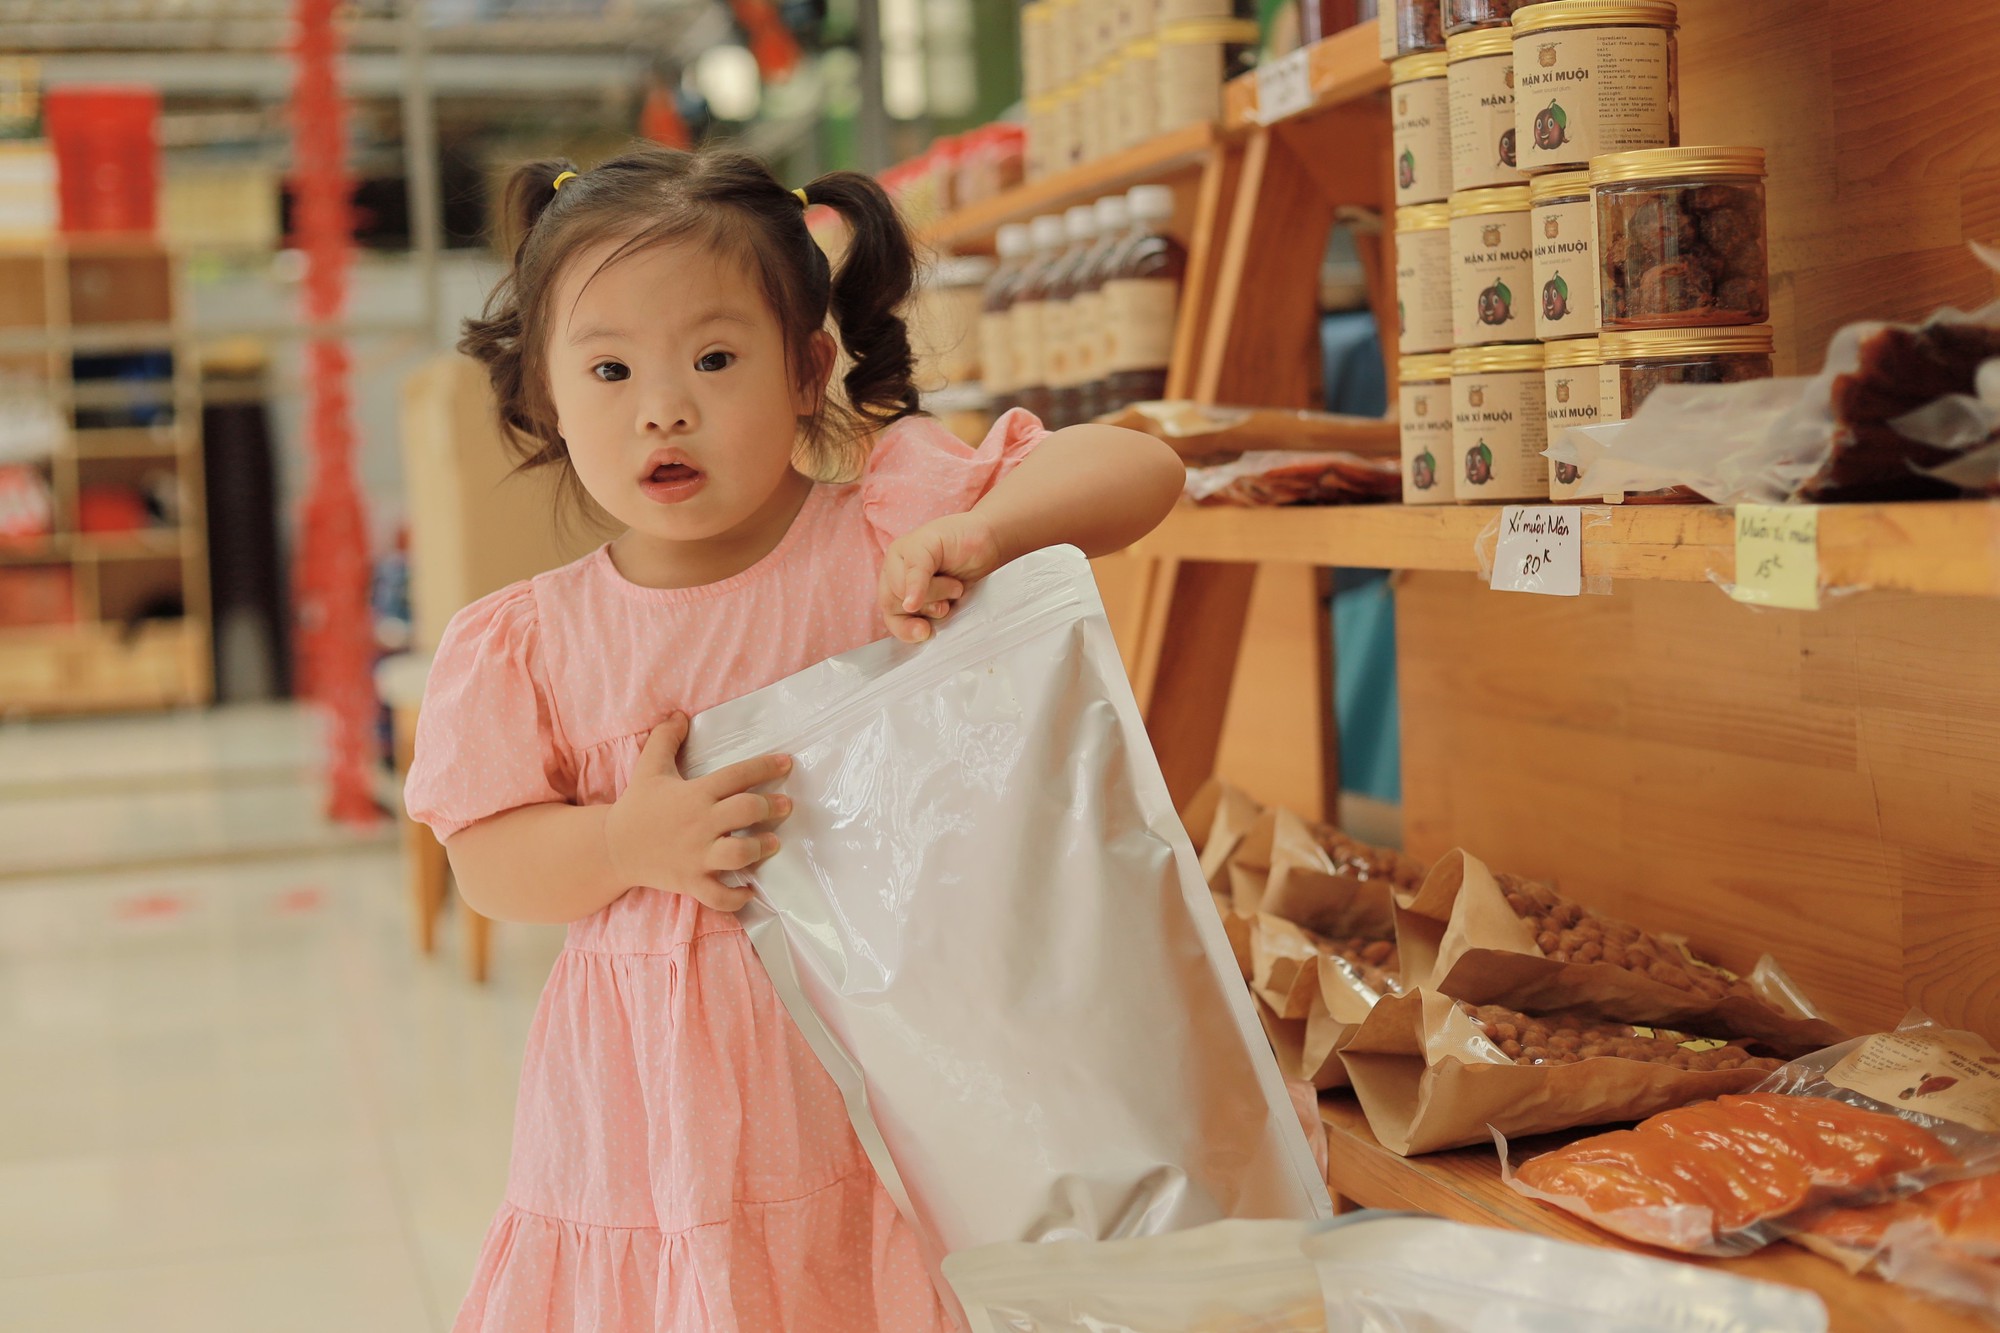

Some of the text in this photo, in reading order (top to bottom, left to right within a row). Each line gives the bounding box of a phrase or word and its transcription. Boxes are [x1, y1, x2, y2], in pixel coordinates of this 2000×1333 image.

[1522, 67, 1589, 88] MẬN XÍ MUỘI
[1481, 94, 1506, 108] MẬN
[1547, 242, 1556, 254] XÍ
[1557, 239, 1588, 254] MUỘI
[1464, 250, 1484, 264] MẬN
[1487, 250, 1497, 262] XÍ
[1500, 248, 1532, 262] MUỘI
[1472, 411, 1481, 422] XÍ
[1483, 409, 1513, 423] MUỘI
[1559, 406, 1567, 418] XÍ
[1569, 404, 1597, 419] MUỘI
[1508, 509, 1525, 535] Xí
